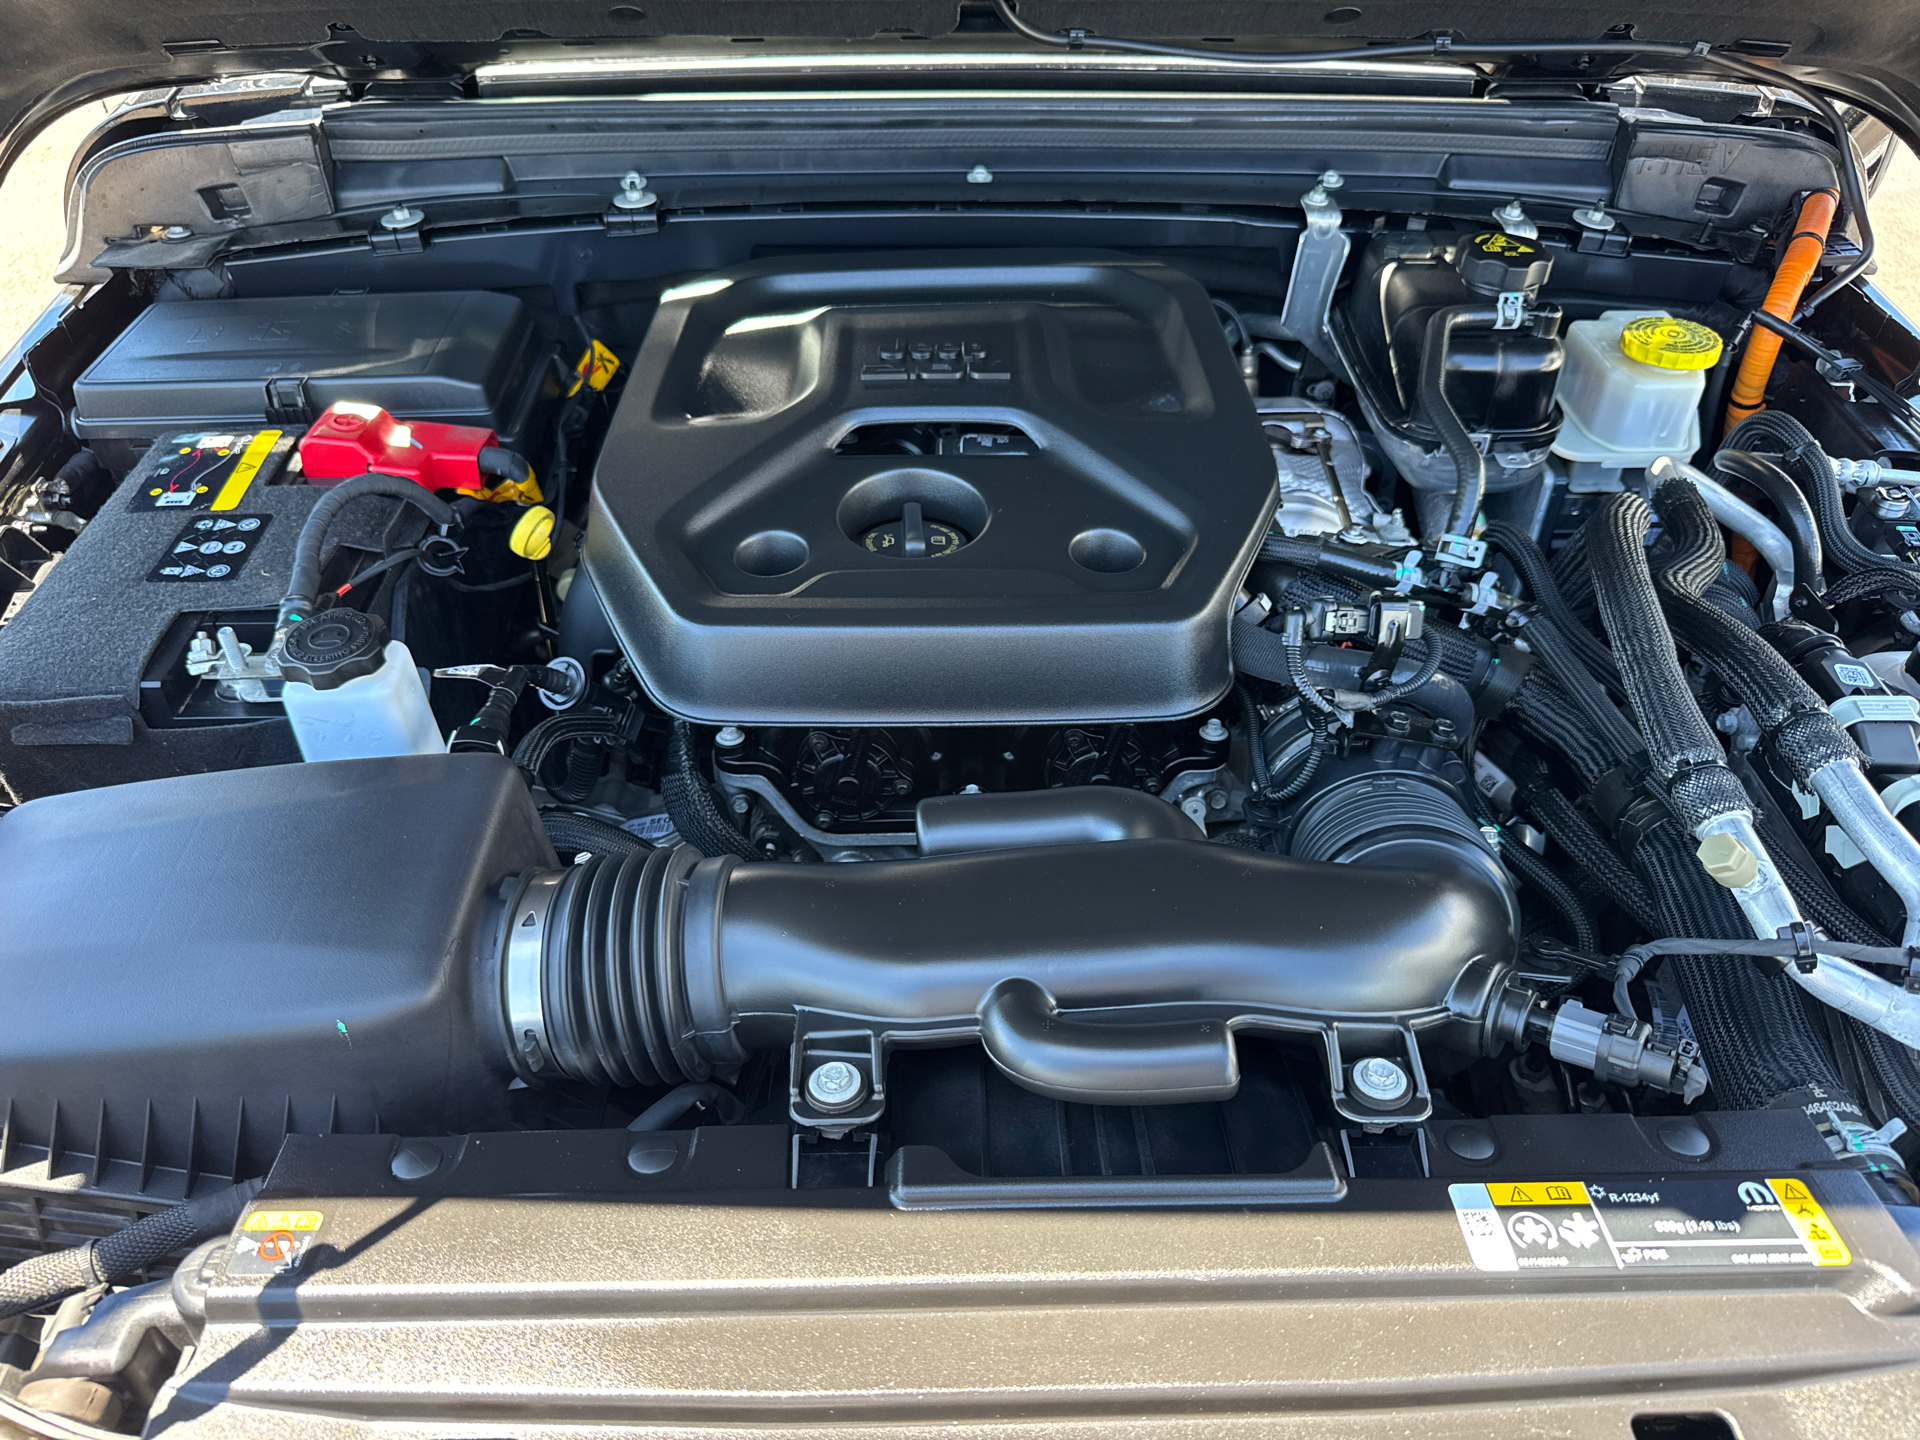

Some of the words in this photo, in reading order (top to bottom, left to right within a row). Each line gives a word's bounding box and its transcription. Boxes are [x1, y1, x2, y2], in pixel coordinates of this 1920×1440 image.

[1636, 143, 1746, 175] PHEV
[877, 337, 987, 363] Jeep
[320, 611, 366, 624] APPROVED
[304, 648, 351, 662] STEERING
[1609, 1192, 1660, 1204] R-1234yf
[1716, 1220, 1740, 1234] lbs)
